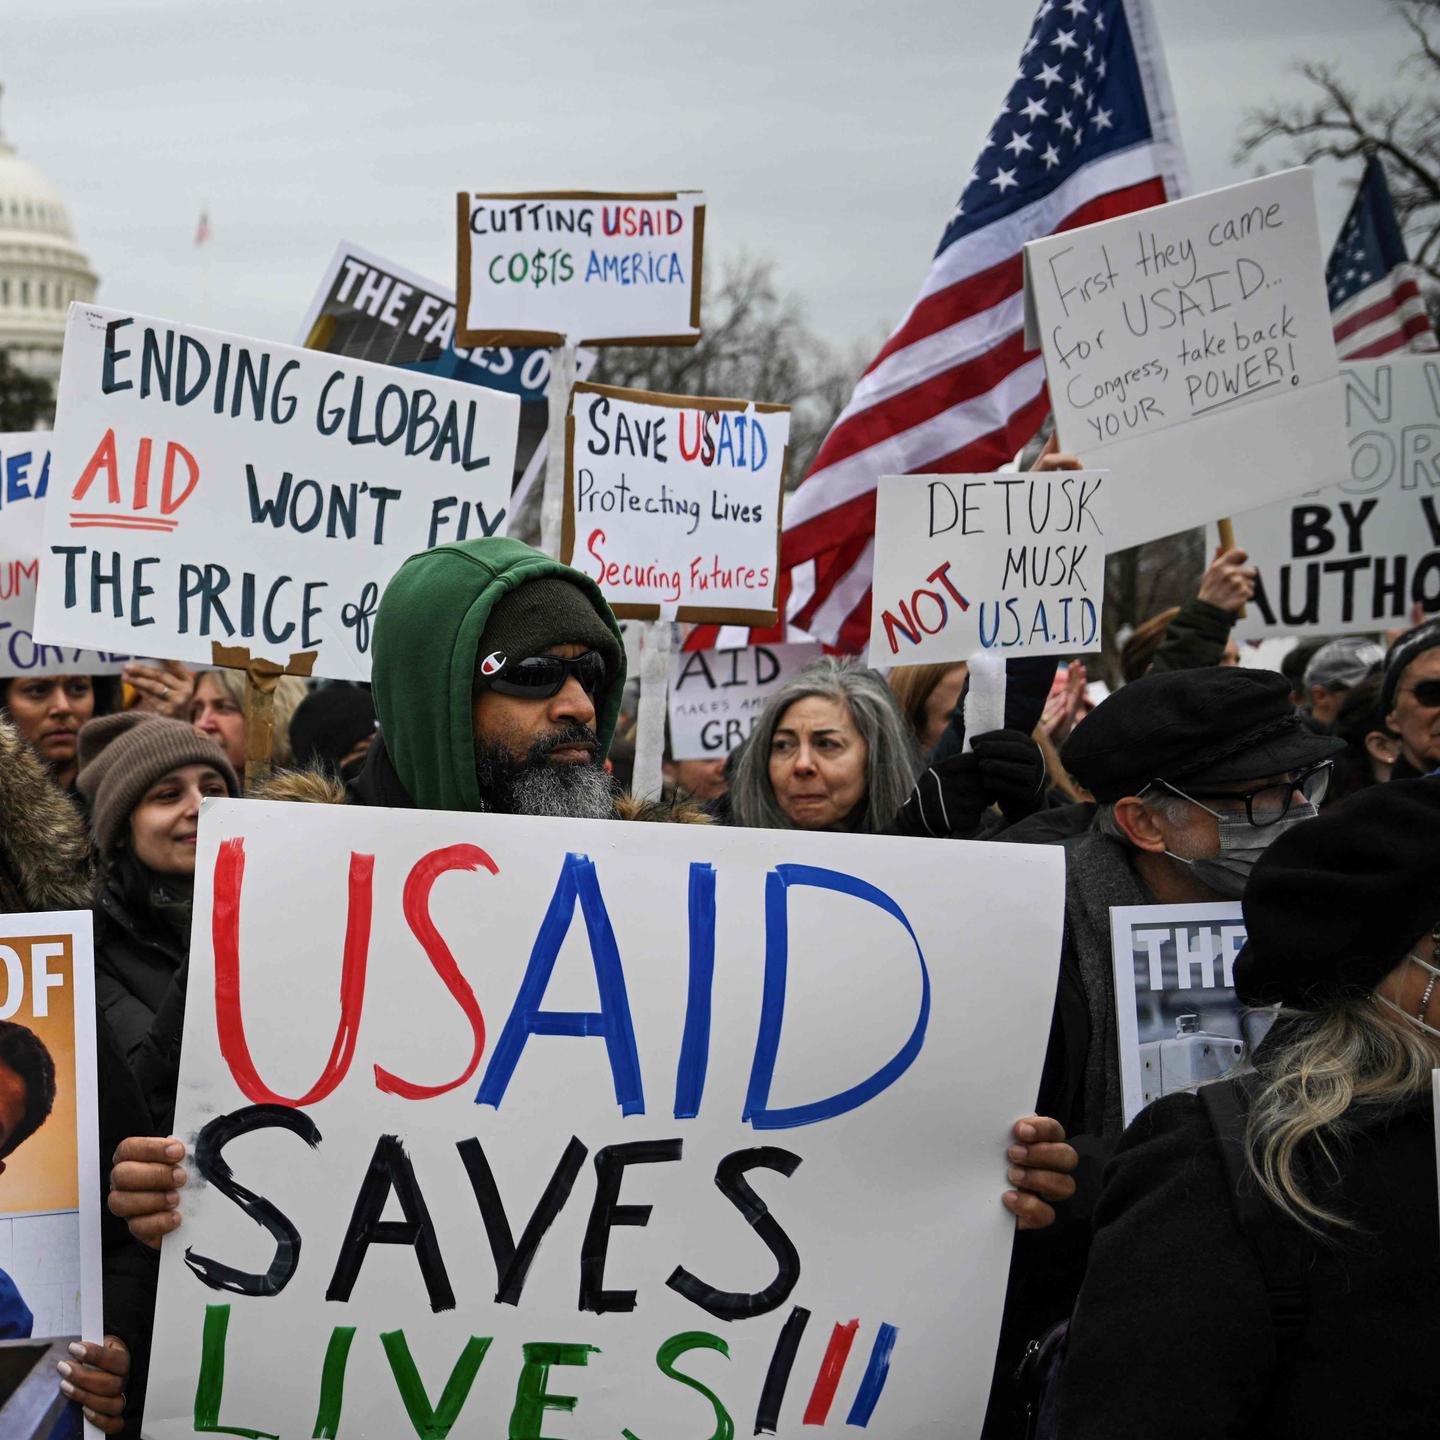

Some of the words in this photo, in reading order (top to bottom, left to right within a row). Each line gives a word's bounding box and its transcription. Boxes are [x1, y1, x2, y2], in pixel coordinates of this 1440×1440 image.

[470, 204, 593, 236] CUTTING
[602, 205, 684, 236] USAID
[489, 249, 575, 288] CO$TS
[585, 251, 685, 284] AMERICA
[1049, 246, 1120, 317] First
[1136, 232, 1198, 289] they
[1209, 203, 1284, 247] came
[336, 259, 413, 327] THE
[1053, 326, 1104, 369] for
[1177, 332, 1226, 366] take
[1234, 305, 1297, 350] back
[102, 317, 301, 424] ENDING
[316, 370, 491, 471] GLOBAL
[1088, 398, 1164, 440] YOUR
[1186, 344, 1300, 406] POWER!
[679, 410, 768, 473] USAID
[71, 428, 200, 515] AID
[246, 464, 402, 545] WON'T
[712, 490, 763, 523] Lives
[928, 479, 1103, 537] DETUSK
[1292, 497, 1379, 559] BY
[588, 529, 681, 602] Securing
[690, 555, 769, 590] Futures
[1002, 545, 1087, 591] MUSK
[51, 545, 161, 627] THE
[177, 563, 329, 648] PRICE
[341, 582, 378, 653] of
[881, 560, 970, 654] NOT
[675, 646, 781, 690] AID
[675, 700, 730, 714] MAKES
[212, 837, 931, 1130] USAID
[184, 1102, 803, 1321] SAVES
